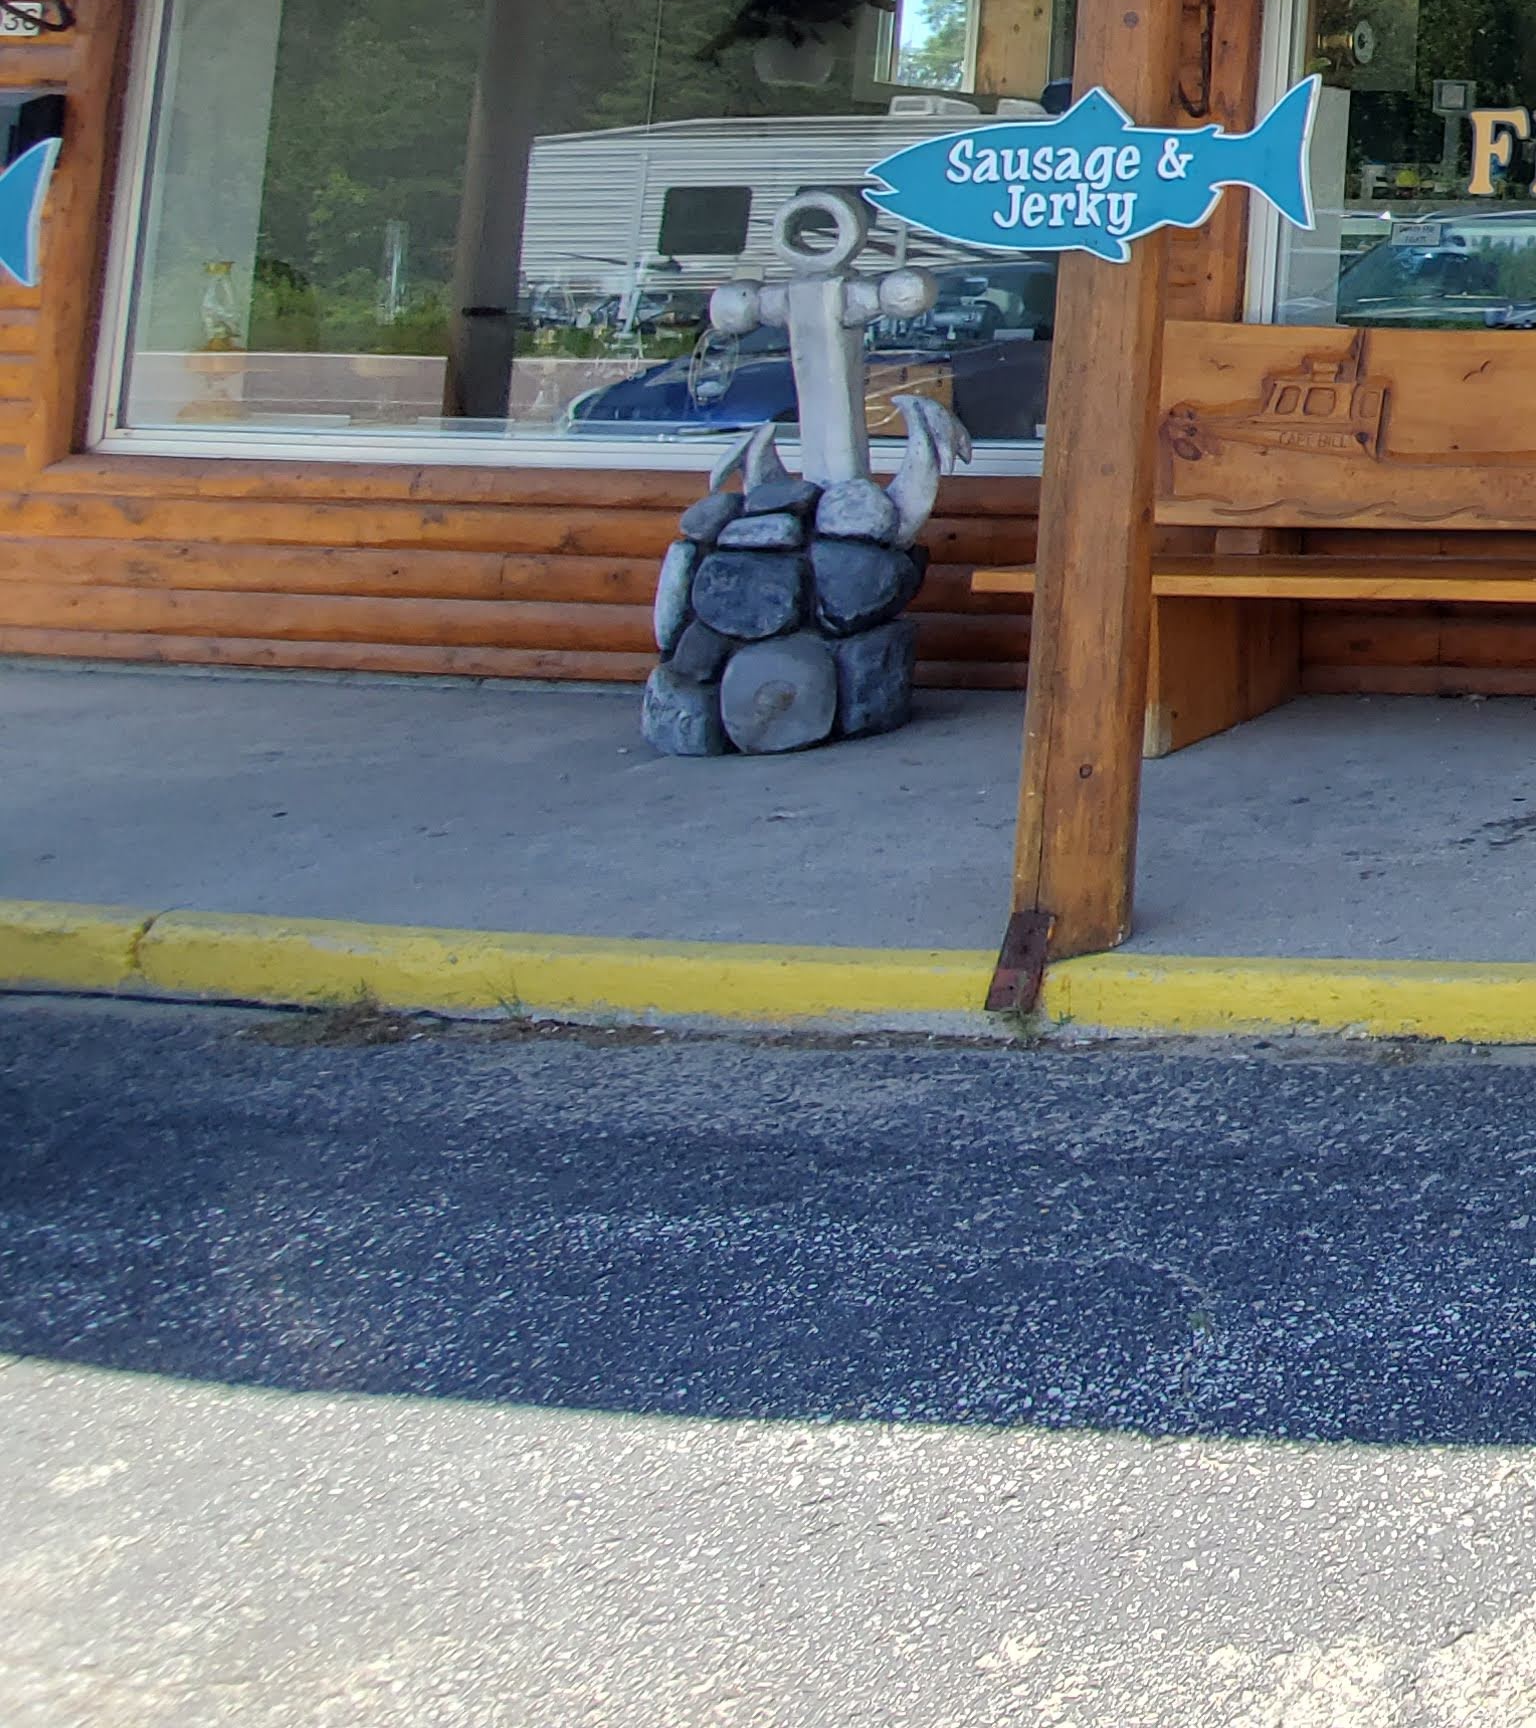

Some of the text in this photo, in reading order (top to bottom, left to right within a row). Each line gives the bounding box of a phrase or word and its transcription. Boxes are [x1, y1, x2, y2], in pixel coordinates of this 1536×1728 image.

[946, 137, 1194, 189] Sausage &
[993, 183, 1138, 236] Jerky
